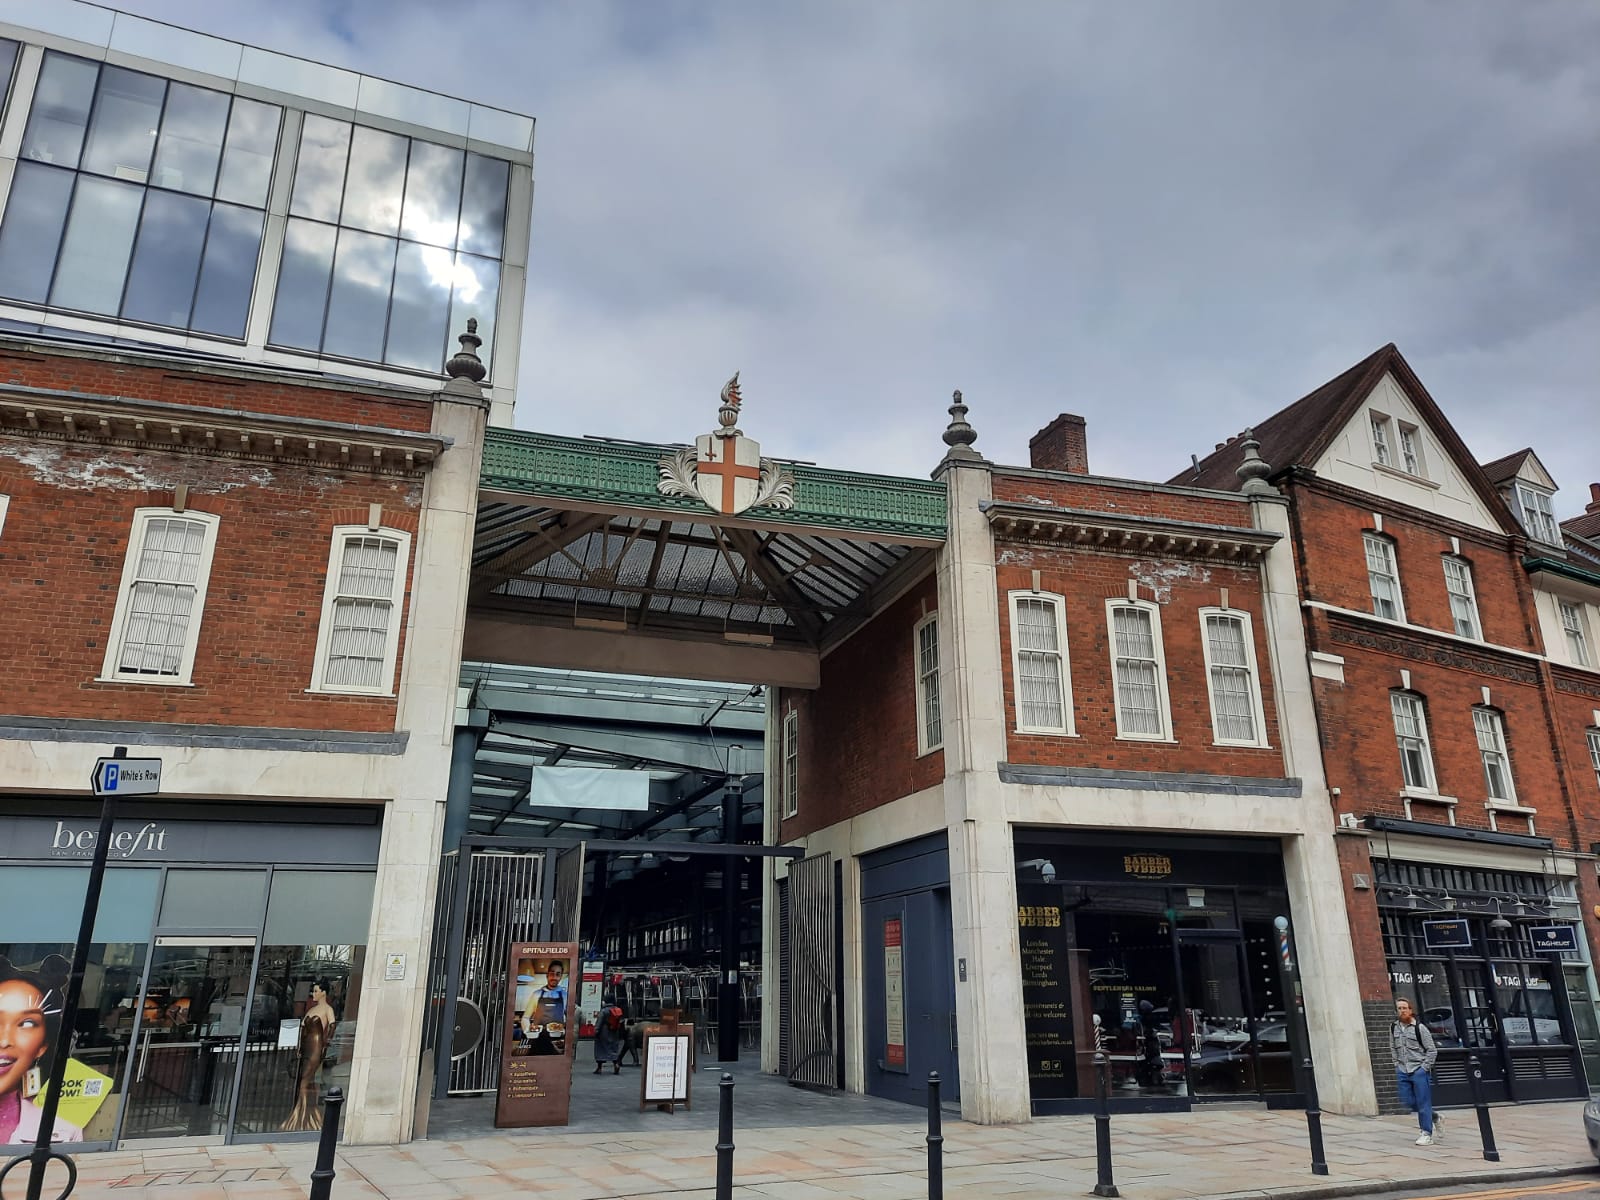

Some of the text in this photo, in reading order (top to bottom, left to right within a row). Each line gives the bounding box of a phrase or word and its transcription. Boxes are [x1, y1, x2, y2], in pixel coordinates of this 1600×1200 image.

[106, 767, 158, 788] P White's Row
[1124, 856, 1170, 865] BARBER
[1018, 906, 1060, 916] ARBER
[60, 1079, 83, 1089] OOK
